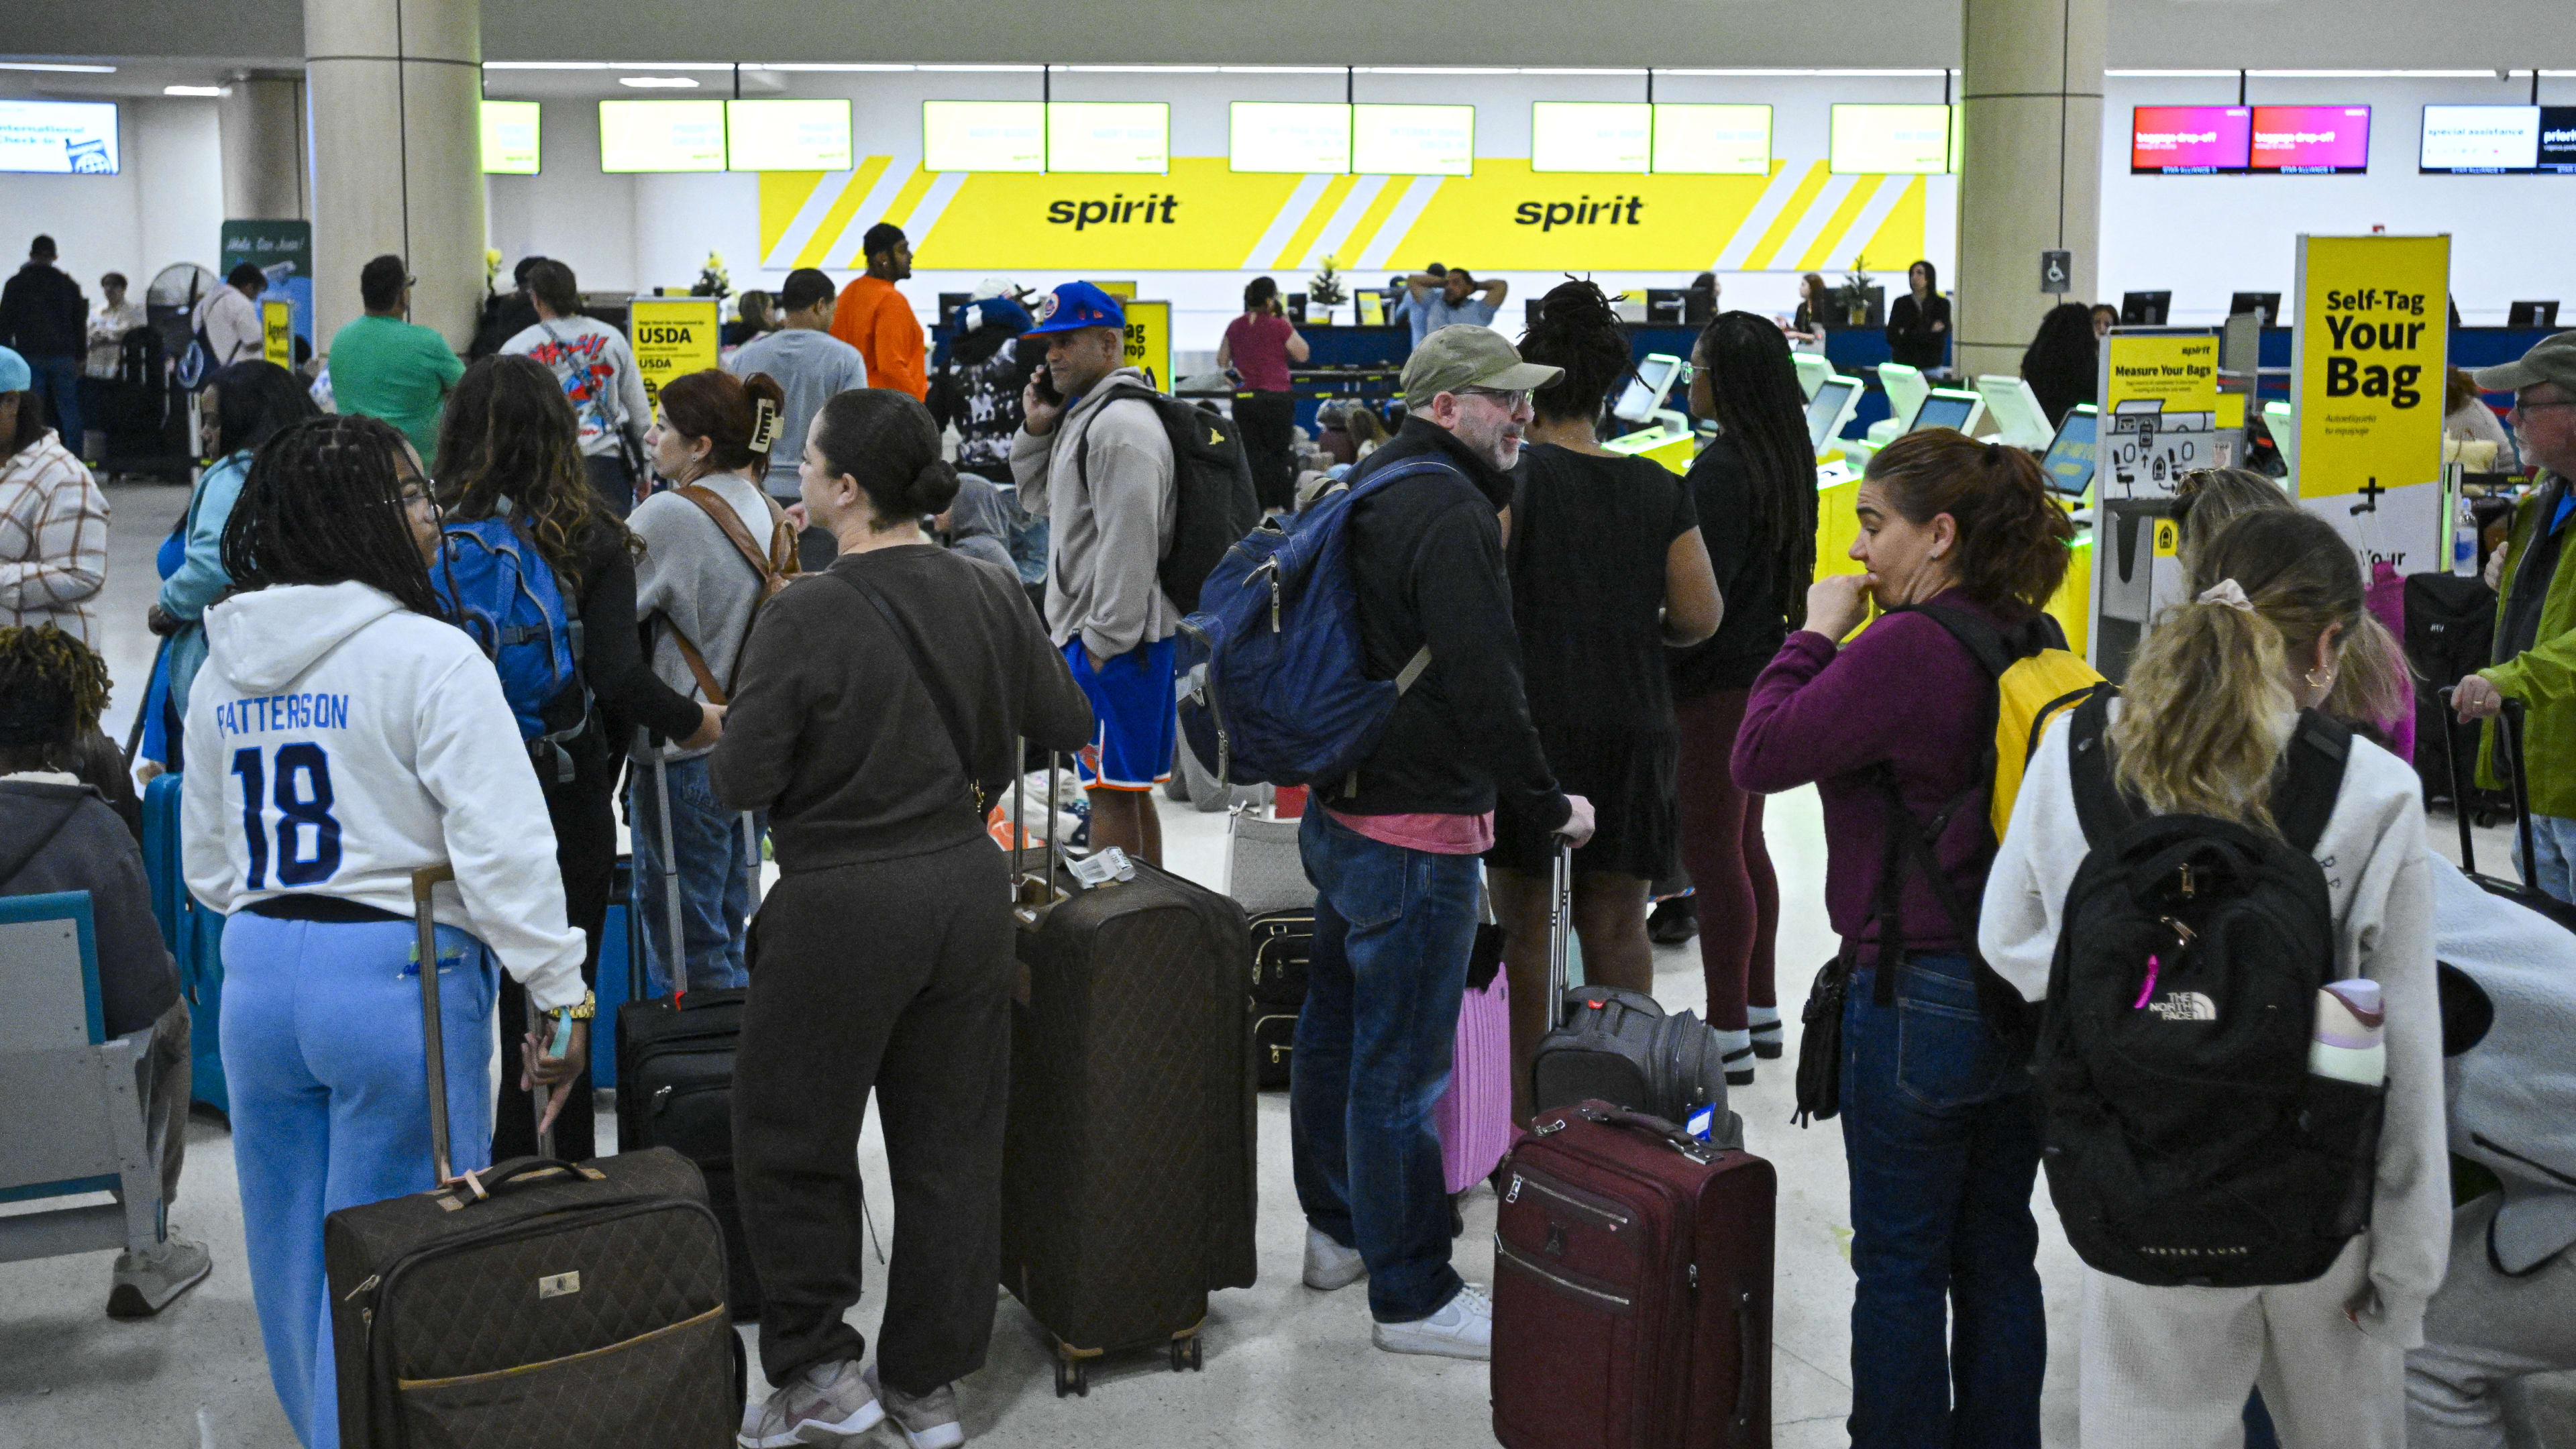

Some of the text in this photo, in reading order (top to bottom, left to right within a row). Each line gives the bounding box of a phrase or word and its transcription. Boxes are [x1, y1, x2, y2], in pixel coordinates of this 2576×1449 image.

[1046, 193, 1178, 231] spirit
[1514, 195, 1644, 233] spirit
[2326, 288, 2425, 315] Self-Tag
[639, 327, 692, 343] USDA
[1124, 324, 1145, 344] ag
[2325, 315, 2426, 350] Your
[1124, 344, 1146, 360] rop
[639, 359, 672, 369] USDA
[2116, 365, 2211, 378] Measure Your Bags
[2326, 356, 2422, 410] Bag
[217, 693, 350, 739] PATTERSON
[231, 741, 343, 890] 18
[2149, 1002, 2192, 1012] NORTH
[2167, 991, 2192, 1003] THE
[2162, 1011, 2193, 1020] FACE
